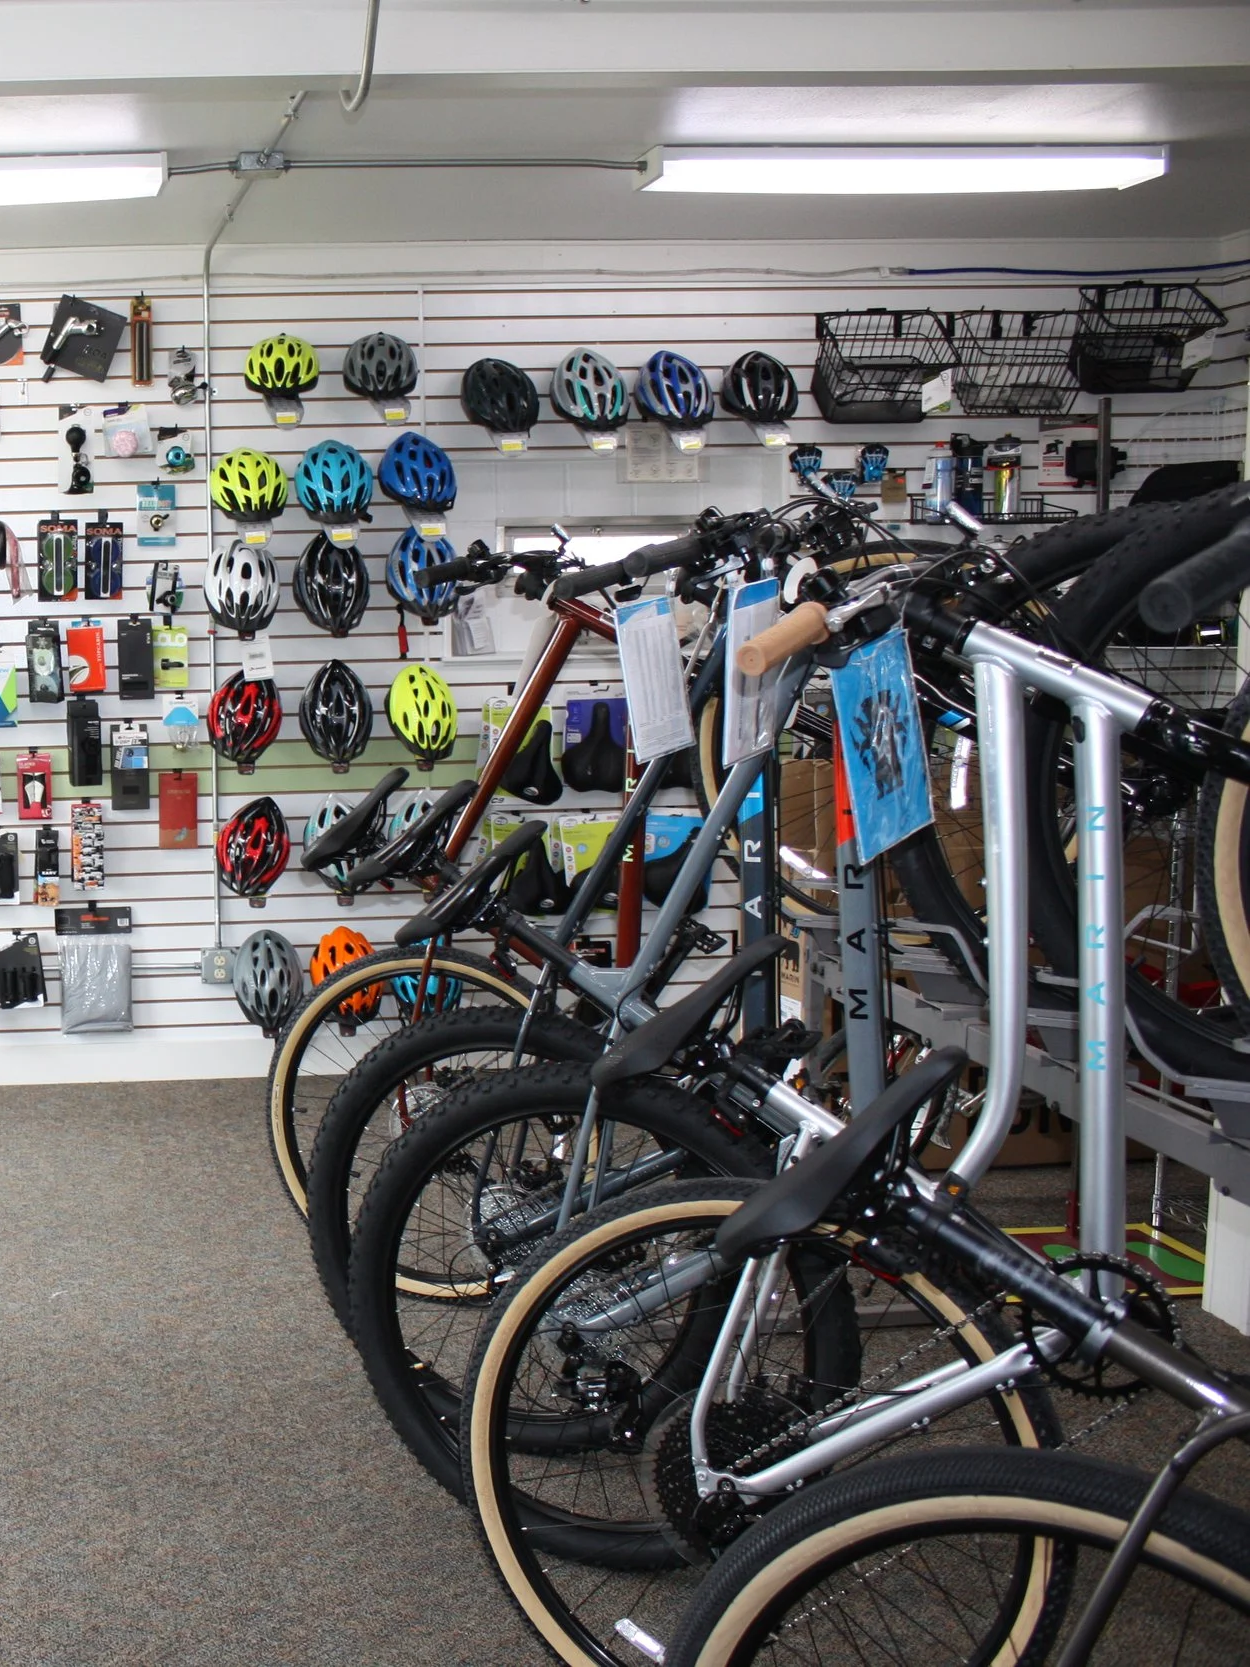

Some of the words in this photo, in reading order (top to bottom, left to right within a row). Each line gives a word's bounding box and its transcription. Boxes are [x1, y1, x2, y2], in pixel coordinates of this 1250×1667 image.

[40, 524, 77, 533] SOMA
[86, 527, 122, 536] SOMA
[1086, 806, 1107, 1071] MARIN
